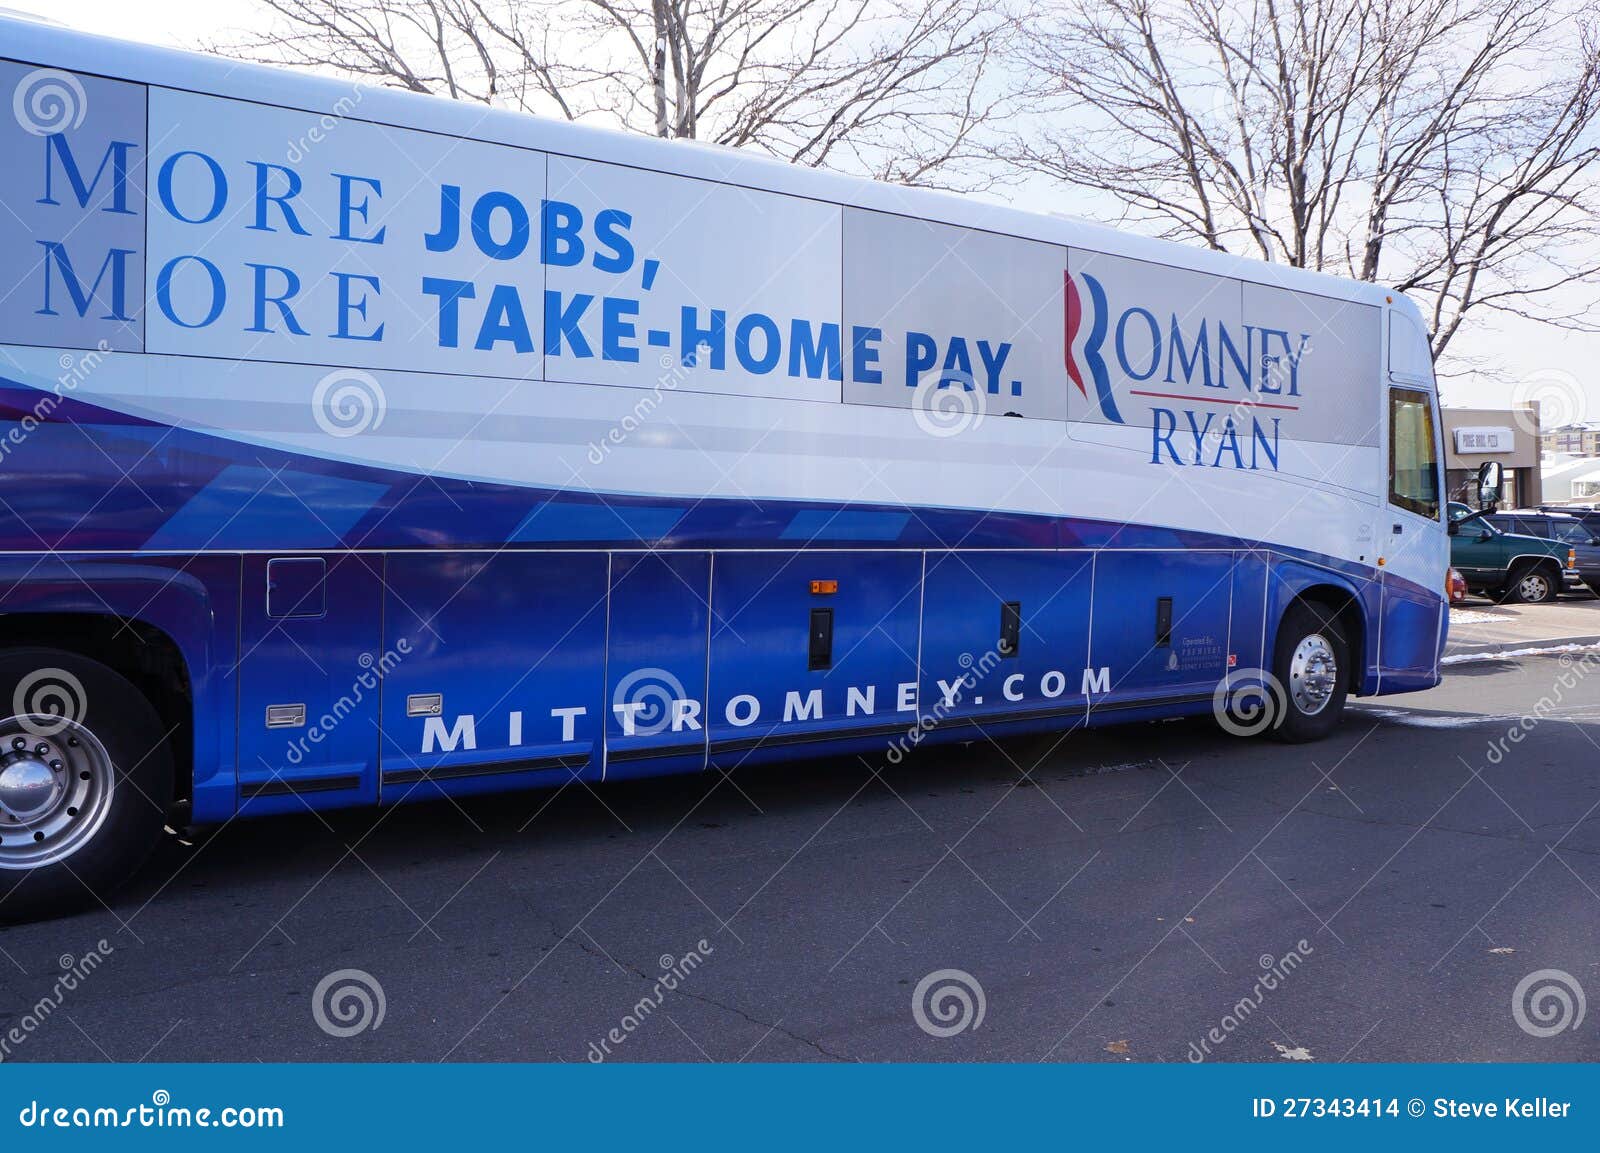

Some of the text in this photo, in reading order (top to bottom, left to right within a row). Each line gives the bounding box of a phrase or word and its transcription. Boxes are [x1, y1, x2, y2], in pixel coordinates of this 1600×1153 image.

[35, 132, 661, 291] MORE JOBS,
[34, 240, 1023, 397] MORE TAKE-HOME PAY.
[1064, 268, 1312, 425] ROMNEY
[1149, 407, 1282, 472] RYAN
[421, 666, 1112, 753] MITTROMNEY.COM
